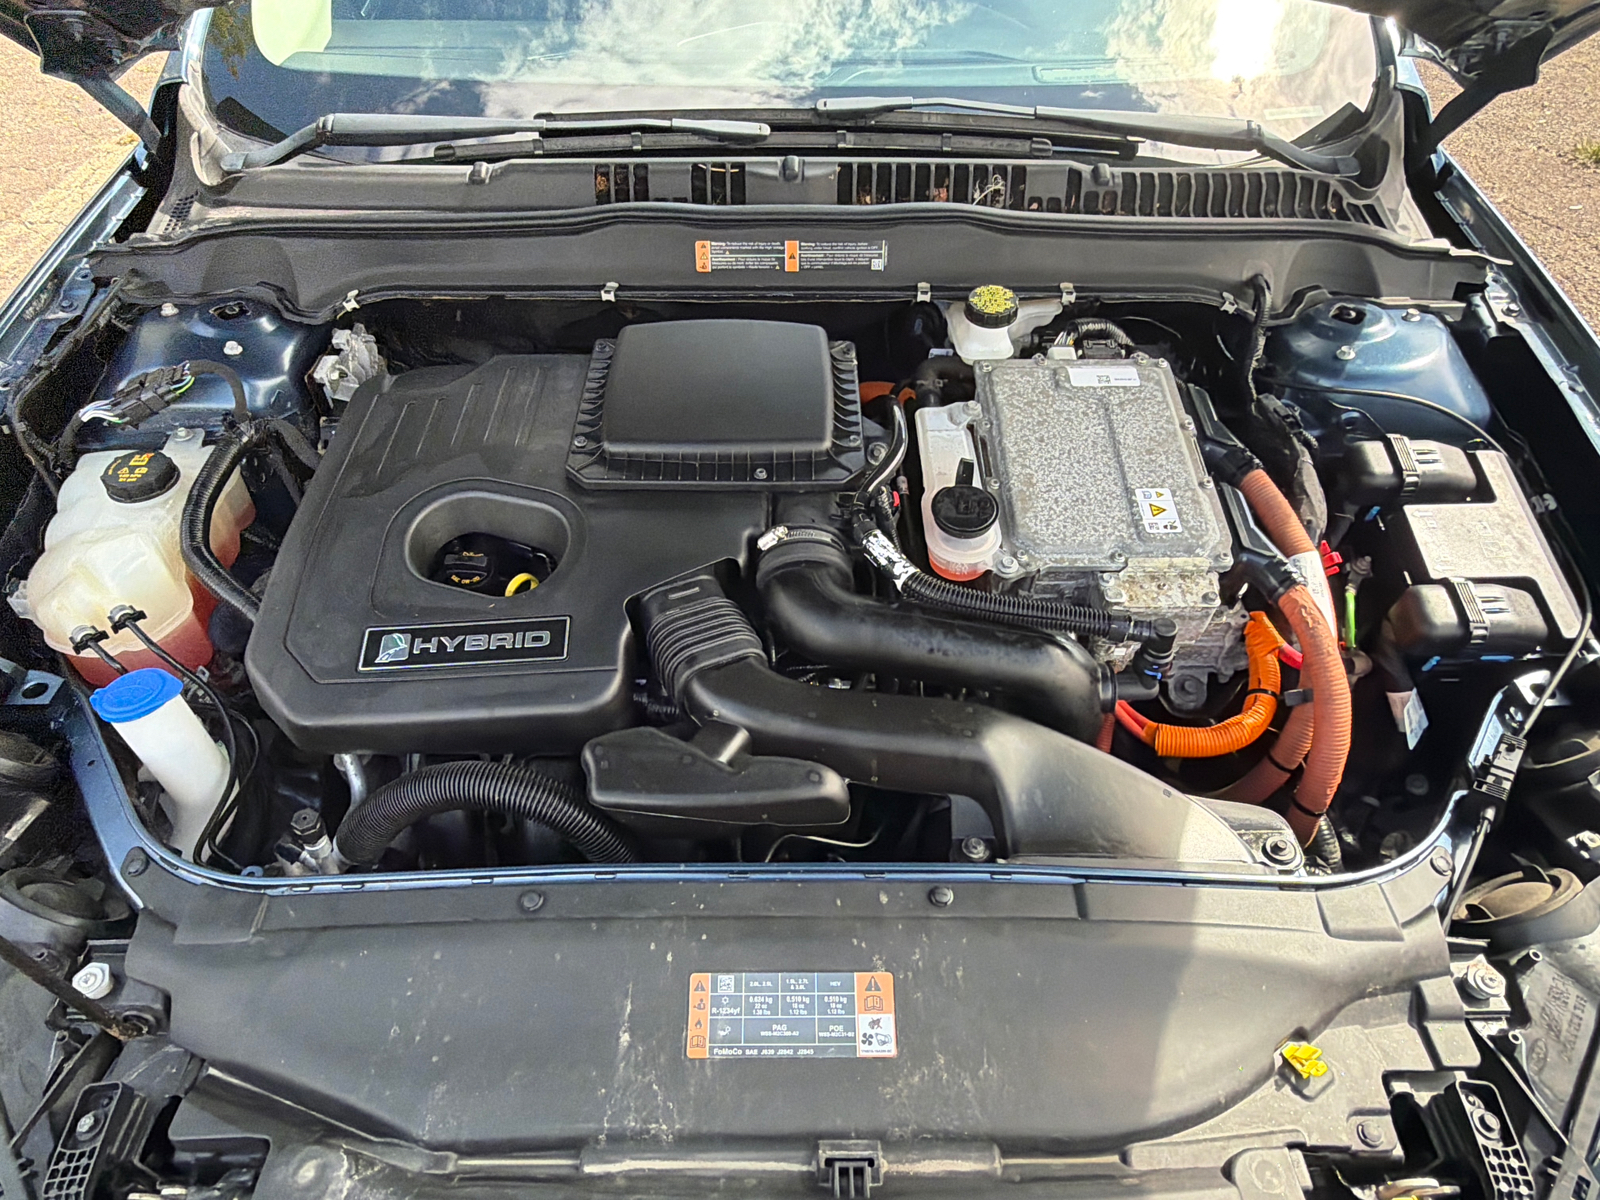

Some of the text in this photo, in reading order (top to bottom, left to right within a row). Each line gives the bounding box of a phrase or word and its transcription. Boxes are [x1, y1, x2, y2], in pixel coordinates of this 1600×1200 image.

[413, 631, 550, 654] HYBRID
[766, 996, 773, 1004] kg
[803, 996, 810, 1004] kg
[840, 996, 847, 1004] kg
[712, 1007, 740, 1015] R-1234yf
